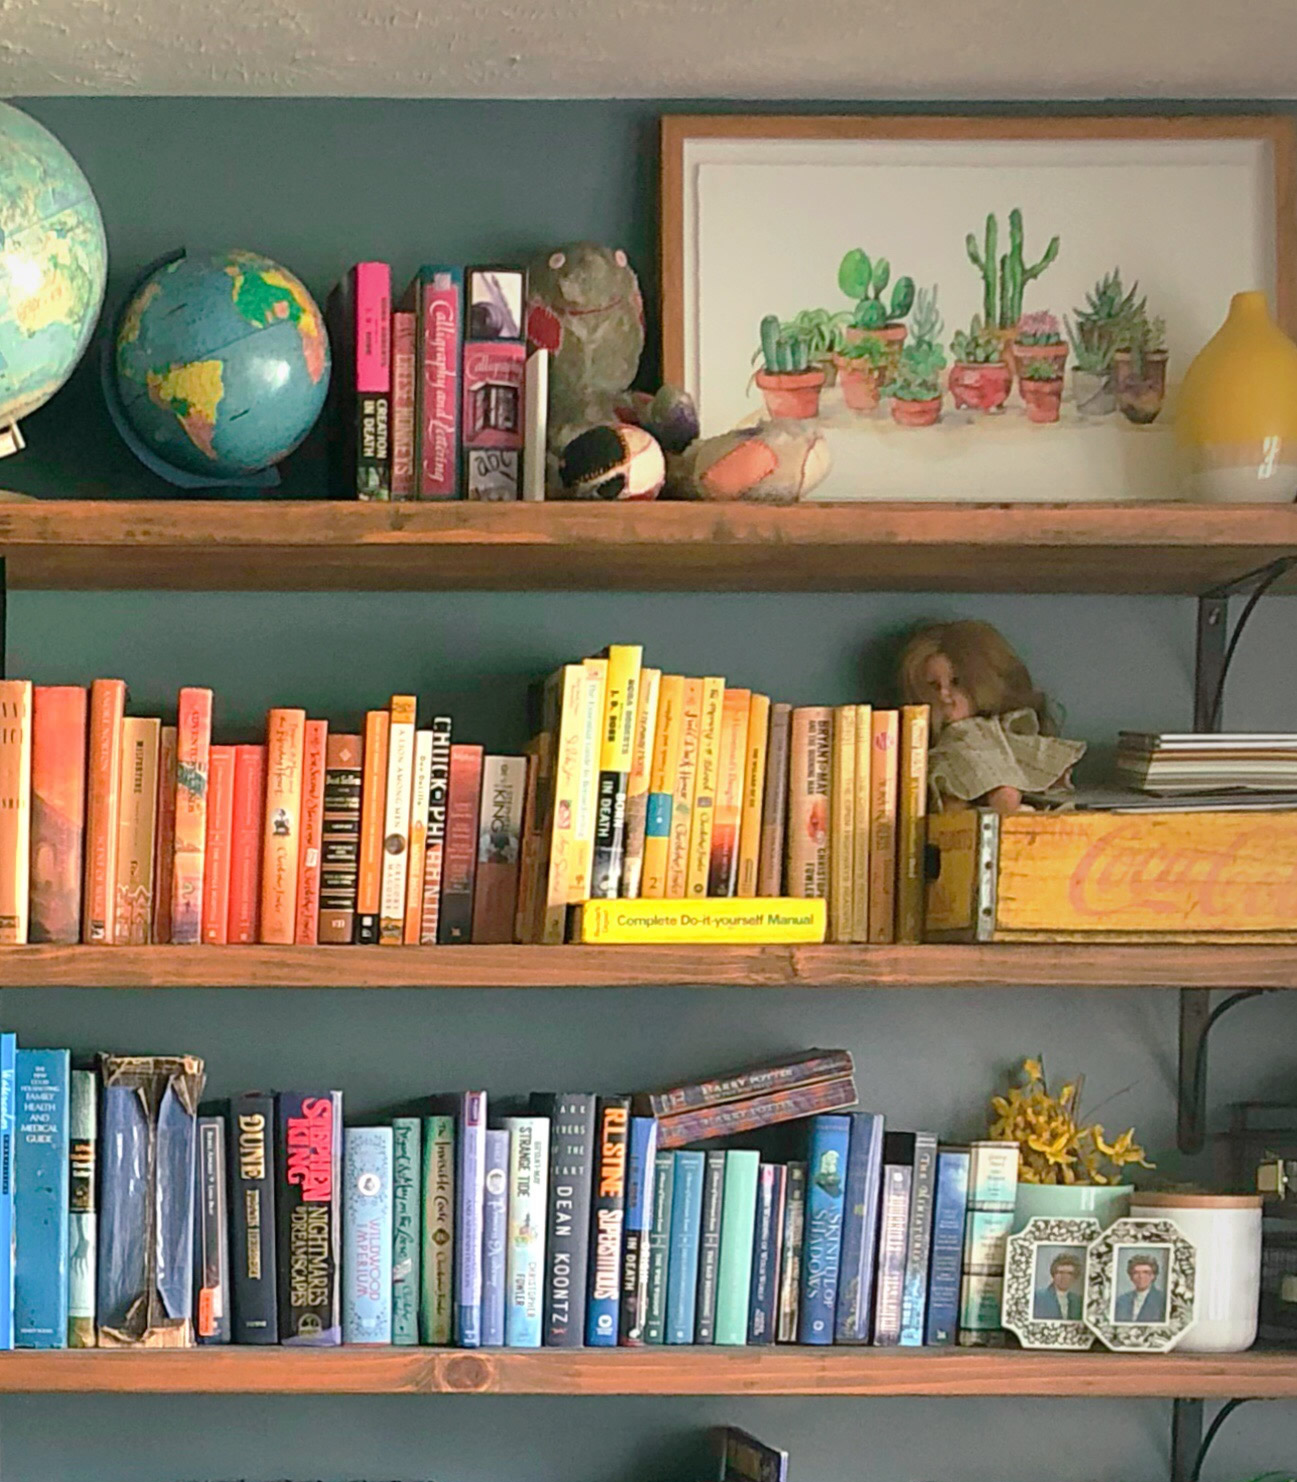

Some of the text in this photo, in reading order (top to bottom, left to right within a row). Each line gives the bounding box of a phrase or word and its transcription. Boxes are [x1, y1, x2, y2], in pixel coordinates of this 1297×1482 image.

[423, 300, 455, 482] Calligraphy and Lettering
[363, 400, 375, 457] IN DEATH
[375, 399, 387, 459] CREATION
[430, 717, 451, 791] CHUCK
[817, 720, 830, 765] BRYANT
[492, 789, 505, 833] KING
[598, 781, 614, 837] IN DEATH
[612, 793, 626, 828] BORN
[816, 772, 828, 796] MAY
[617, 913, 813, 928] Complete Do-it-yourself Manual
[21, 1125, 58, 1133] MEDICAL
[24, 1102, 56, 1112] HEALTH
[30, 1114, 50, 1122] AND
[26, 1134, 52, 1143] GUIDE
[238, 1114, 265, 1180] DUNE
[287, 1117, 310, 1184] KING
[302, 1098, 332, 1202] STEPHEN
[435, 1142, 451, 1191] Invisible
[517, 1126, 531, 1197] STRANGE TIDE
[601, 1143, 623, 1197] STINE
[435, 1196, 449, 1222] Code
[290, 1214, 308, 1307] DREAMSCAPES
[306, 1206, 329, 1306] NIGHTMARES
[356, 1224, 369, 1299] IMPERIUM
[369, 1219, 380, 1301] WILDWOOD
[552, 1186, 572, 1323] DEAN KOONTZ
[593, 1209, 623, 1300] SUPERSTITIOUS
[624, 1237, 637, 1291] IN DEATH
[806, 1210, 827, 1299] SHADOWS
[823, 1213, 841, 1285] SKINFUL
[515, 1273, 526, 1307] FOWLER
